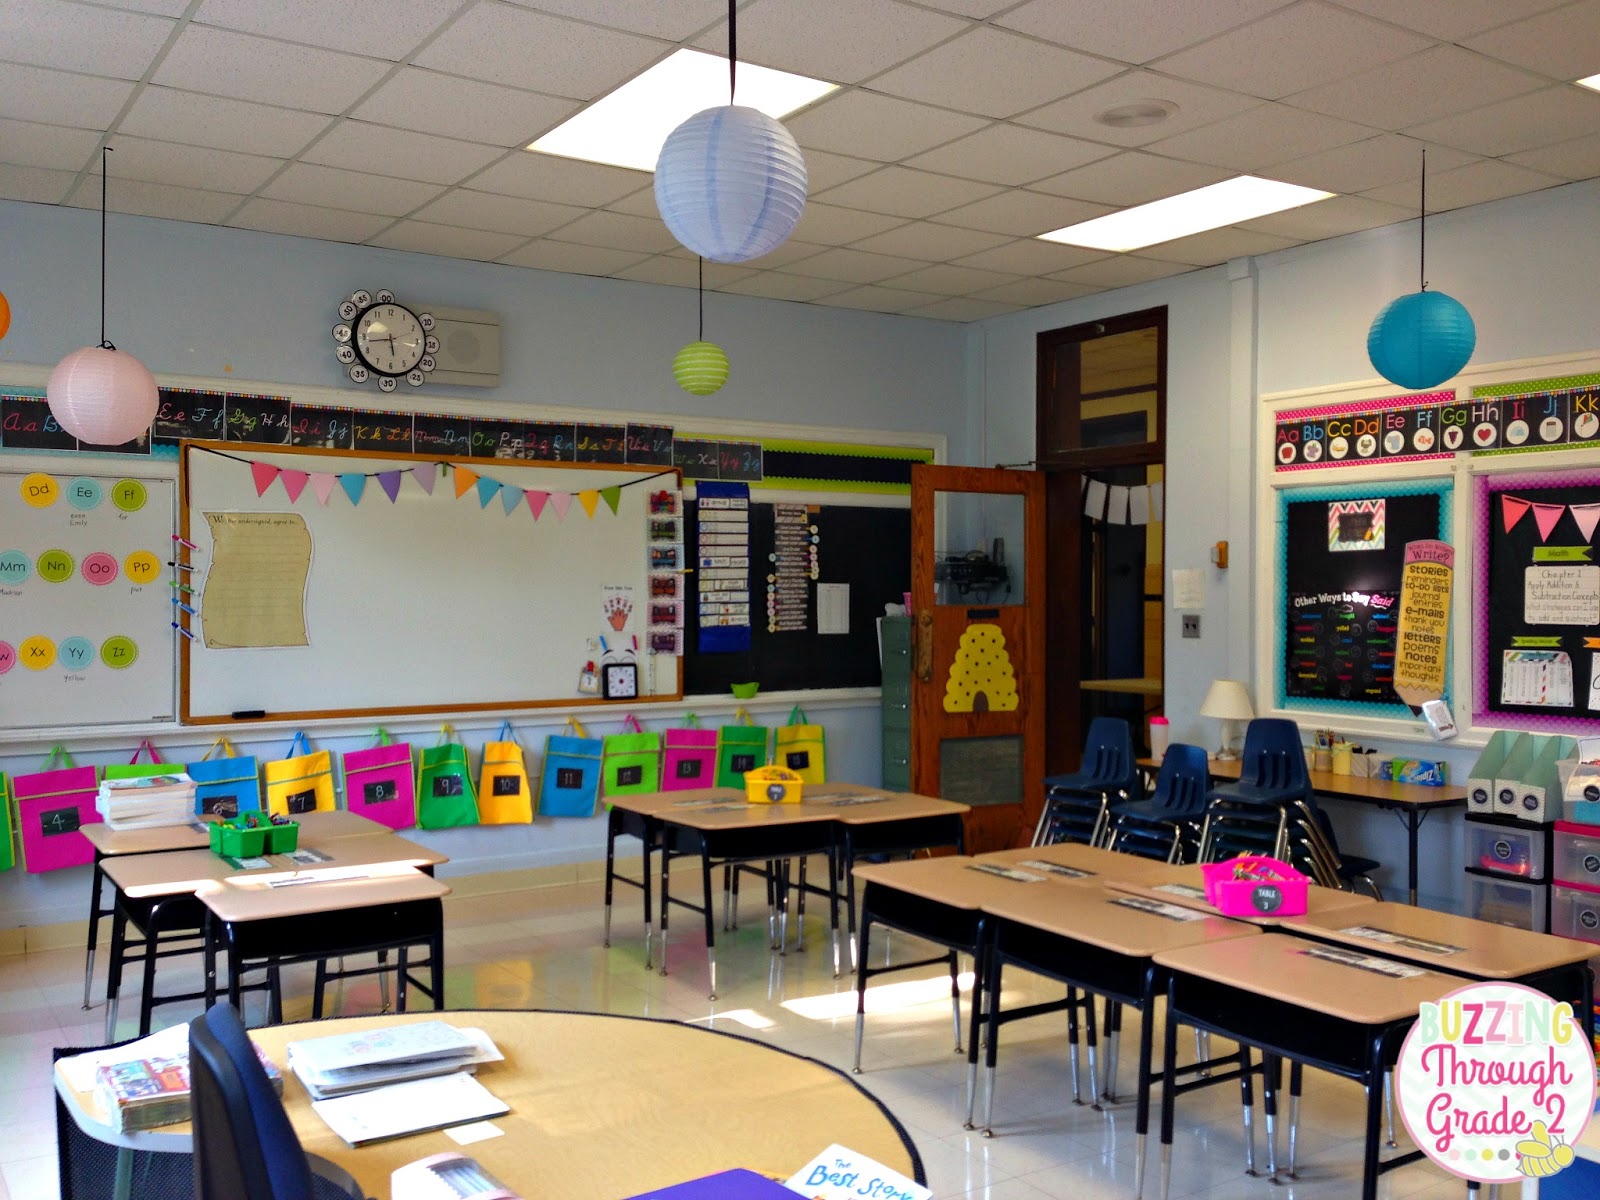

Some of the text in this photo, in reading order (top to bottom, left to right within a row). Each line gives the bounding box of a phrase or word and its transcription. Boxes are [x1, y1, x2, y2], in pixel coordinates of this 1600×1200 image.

[387, 308, 395, 316] 12
[1543, 396, 1558, 417] Jj
[1575, 394, 1599, 413] Kk
[1471, 404, 1499, 423] Hh
[1512, 401, 1525, 420] Ii
[1386, 414, 1406, 429] Ee
[1417, 410, 1433, 428] Ff
[1441, 408, 1467, 427] Gg
[1302, 425, 1324, 441] Bb
[1327, 421, 1351, 438] Cc
[1354, 418, 1380, 436] Dd
[1276, 429, 1300, 444] Aa
[29, 483, 50, 497] Dd
[77, 487, 93, 498] Ee
[124, 489, 135, 500] Ff
[1412, 550, 1450, 564] Write?
[0, 564, 26, 573] Mm
[47, 560, 66, 572] Nn
[89, 562, 110, 574] Oo
[133, 562, 151, 574] Pp
[1406, 576, 1449, 587] reminders
[1541, 569, 1576, 582] Chapter
[1294, 596, 1317, 607] Other
[1318, 593, 1342, 605] Ways
[1342, 592, 1351, 603] to
[1370, 594, 1395, 607] Said
[1410, 591, 1441, 601] journal
[1531, 591, 1572, 600] Subtraction
[1413, 599, 1443, 609] entries
[1405, 606, 1445, 619] e-mails
[1404, 615, 1445, 627] thank you
[30, 646, 46, 657] Xx
[69, 647, 84, 659] Yy
[113, 646, 126, 658] Zz
[1403, 642, 1440, 655] poems
[1405, 651, 1438, 664] notes
[1401, 669, 1440, 683] thoughts
[375, 784, 384, 798] 8
[441, 779, 450, 794] 9
[500, 778, 511, 791] 10
[51, 813, 66, 832] 4
[1257, 888, 1277, 899] TABLE
[834, 1158, 852, 1169] The
[804, 1164, 860, 1189] Best
